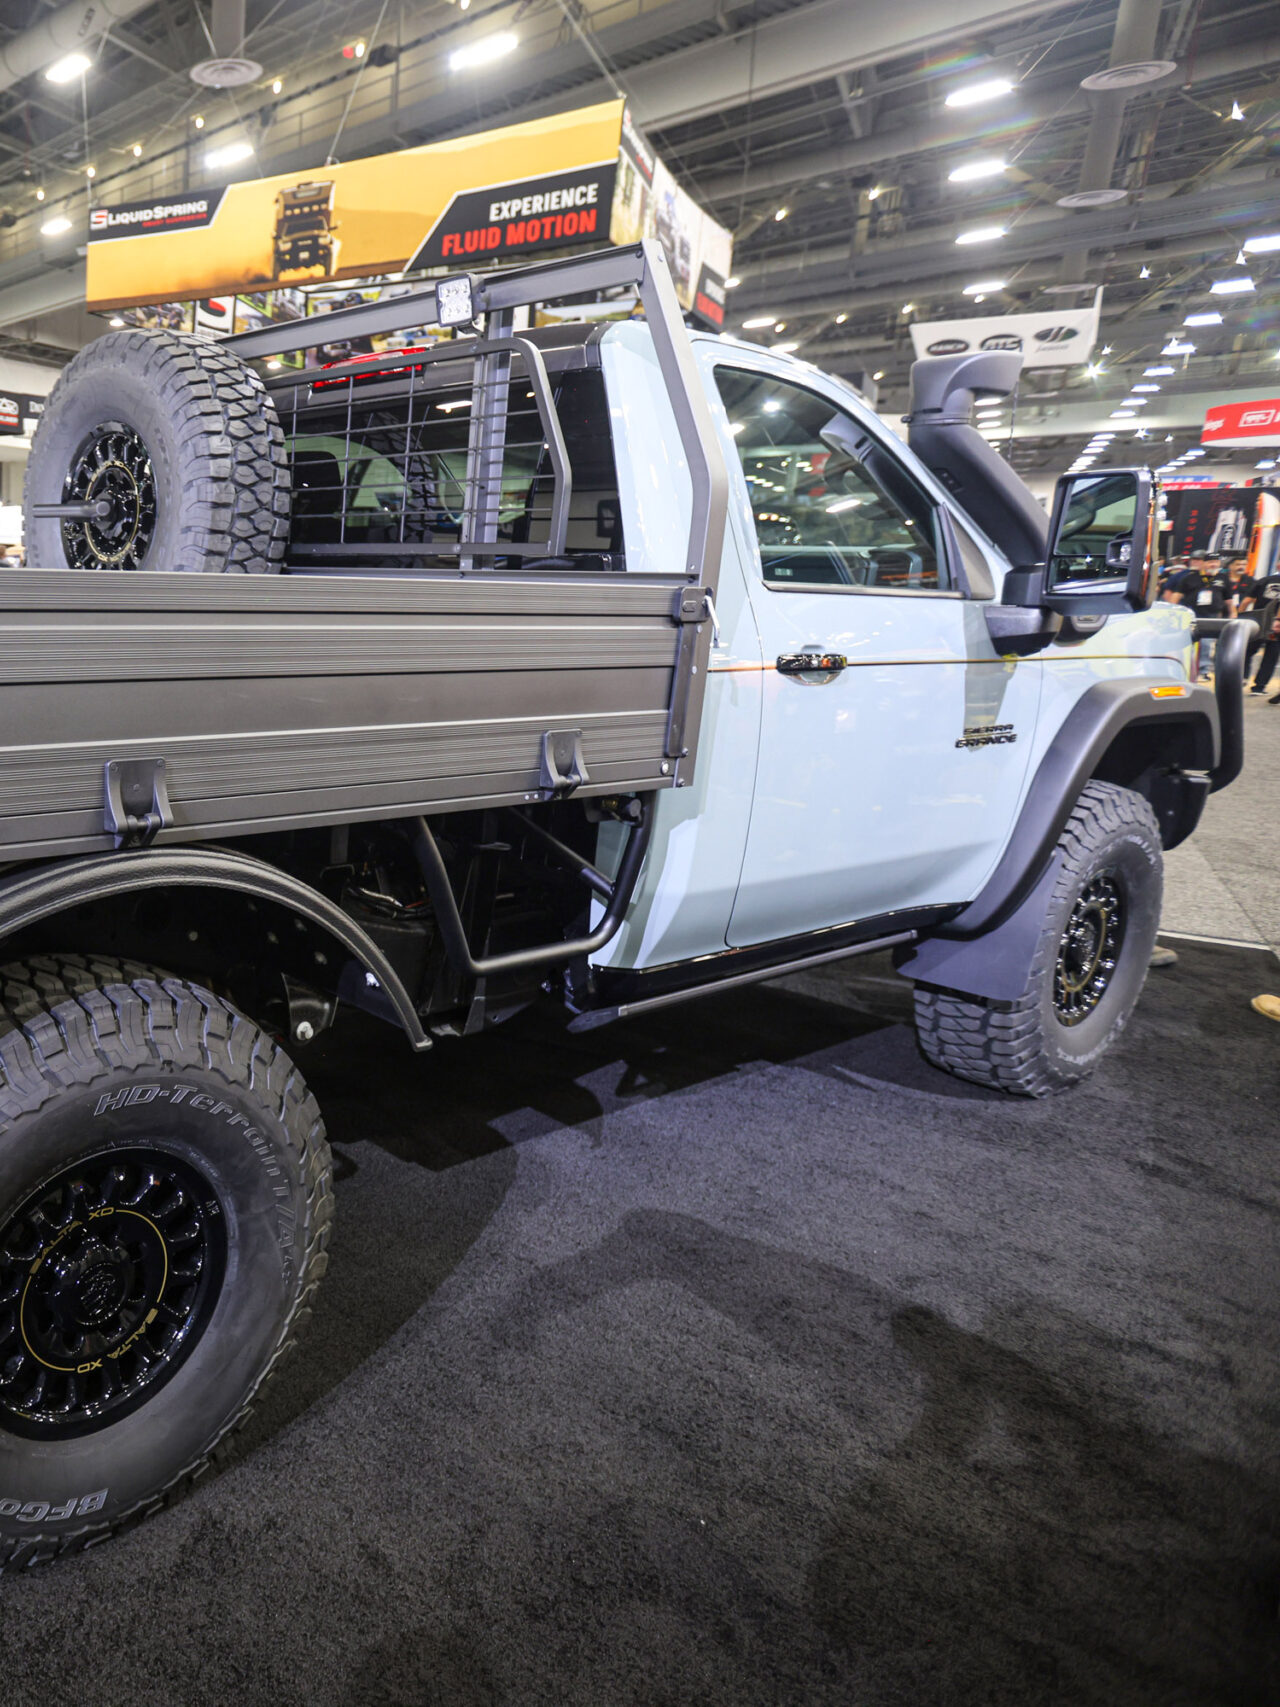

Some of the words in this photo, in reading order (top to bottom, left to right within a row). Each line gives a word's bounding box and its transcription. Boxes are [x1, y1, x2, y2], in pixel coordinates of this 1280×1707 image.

[488, 183, 599, 222] EXPERIENCE
[441, 226, 502, 257] FLUID
[506, 209, 597, 247] MOTION
[955, 733, 1017, 748] GRANDE
[963, 724, 1014, 735] SIERRA
[93, 1083, 281, 1179] HD-Terrain
[87, 1206, 115, 1222] XD
